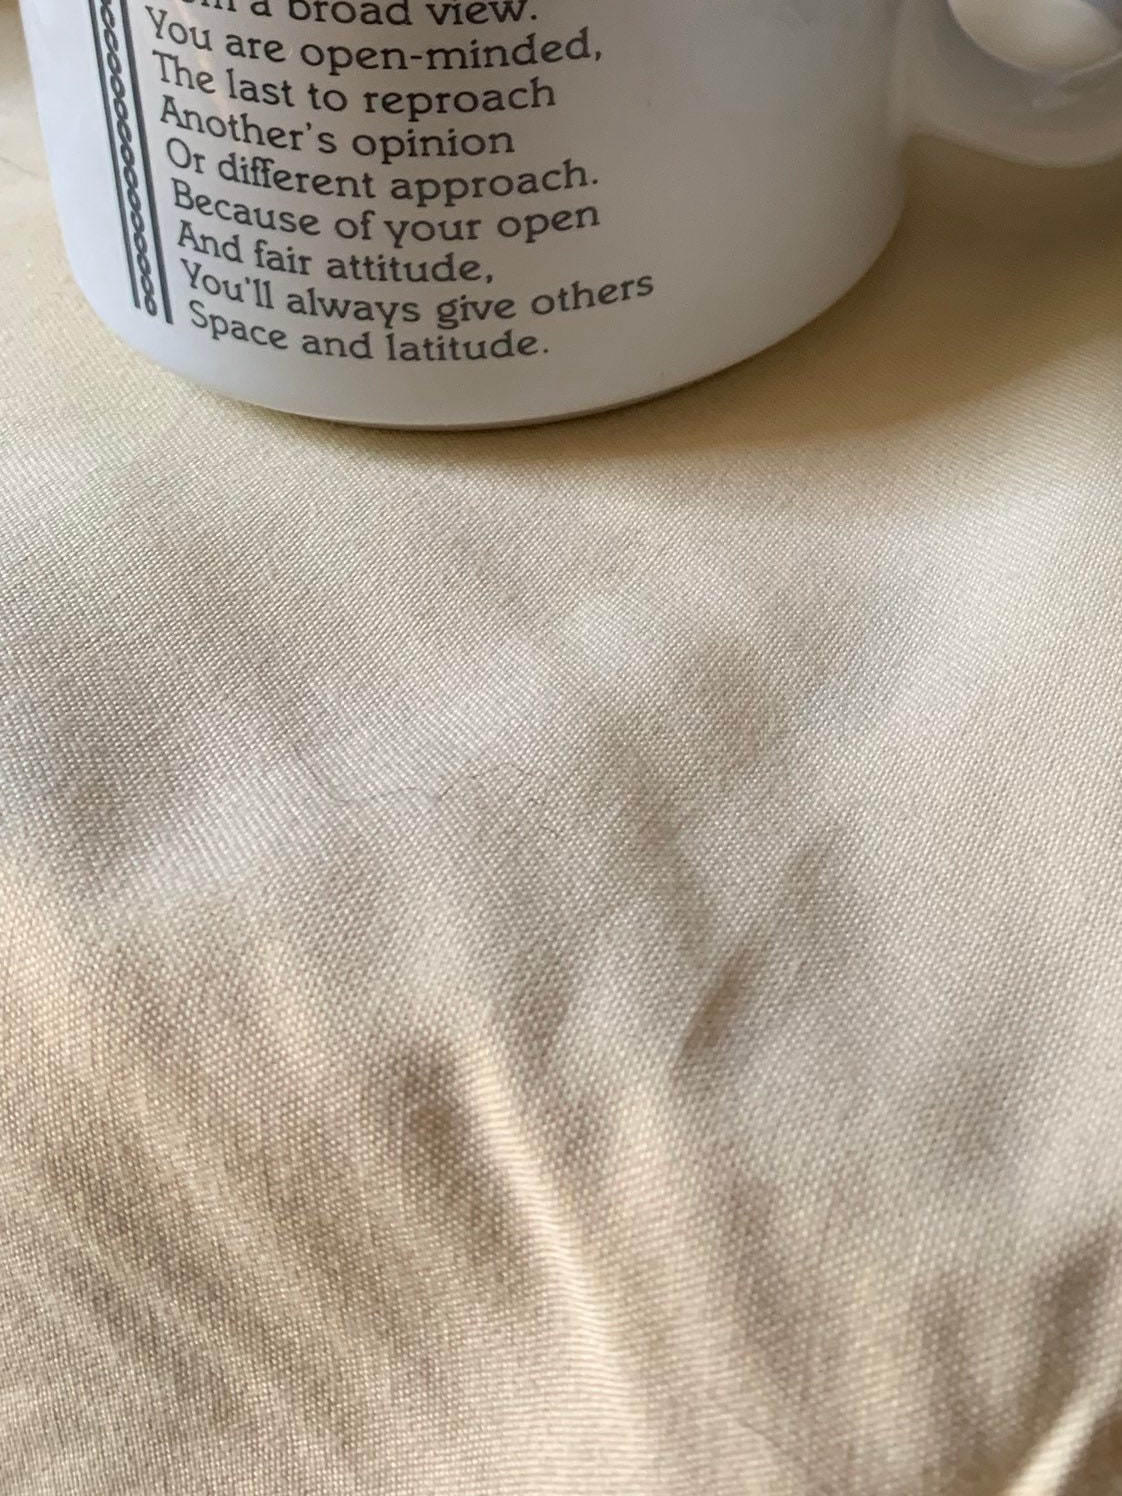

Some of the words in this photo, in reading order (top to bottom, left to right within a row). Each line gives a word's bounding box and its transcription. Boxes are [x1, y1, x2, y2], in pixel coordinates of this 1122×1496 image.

[145, 6, 212, 51] You
[226, 34, 286, 63] are
[300, 26, 601, 76] open-minded,
[152, 50, 215, 94] The
[226, 68, 295, 107] last
[307, 83, 347, 112] to
[363, 77, 556, 122] reproach
[160, 95, 337, 154] Another's
[352, 128, 515, 165] opinion
[167, 138, 205, 174] Or
[218, 152, 376, 198] different
[391, 158, 598, 207] approach.
[171, 177, 320, 236] Because
[335, 210, 375, 240] of
[383, 213, 481, 249] your
[497, 206, 600, 243] open
[178, 220, 243, 263] And
[254, 239, 312, 275] fair
[327, 252, 492, 284] attitude,
[180, 258, 274, 309] You'll
[287, 287, 420, 329] always
[437, 295, 516, 330] give
[531, 275, 654, 315] others
[189, 300, 288, 350] Space
[302, 332, 374, 359] and
[386, 329, 548, 361] latitude.
